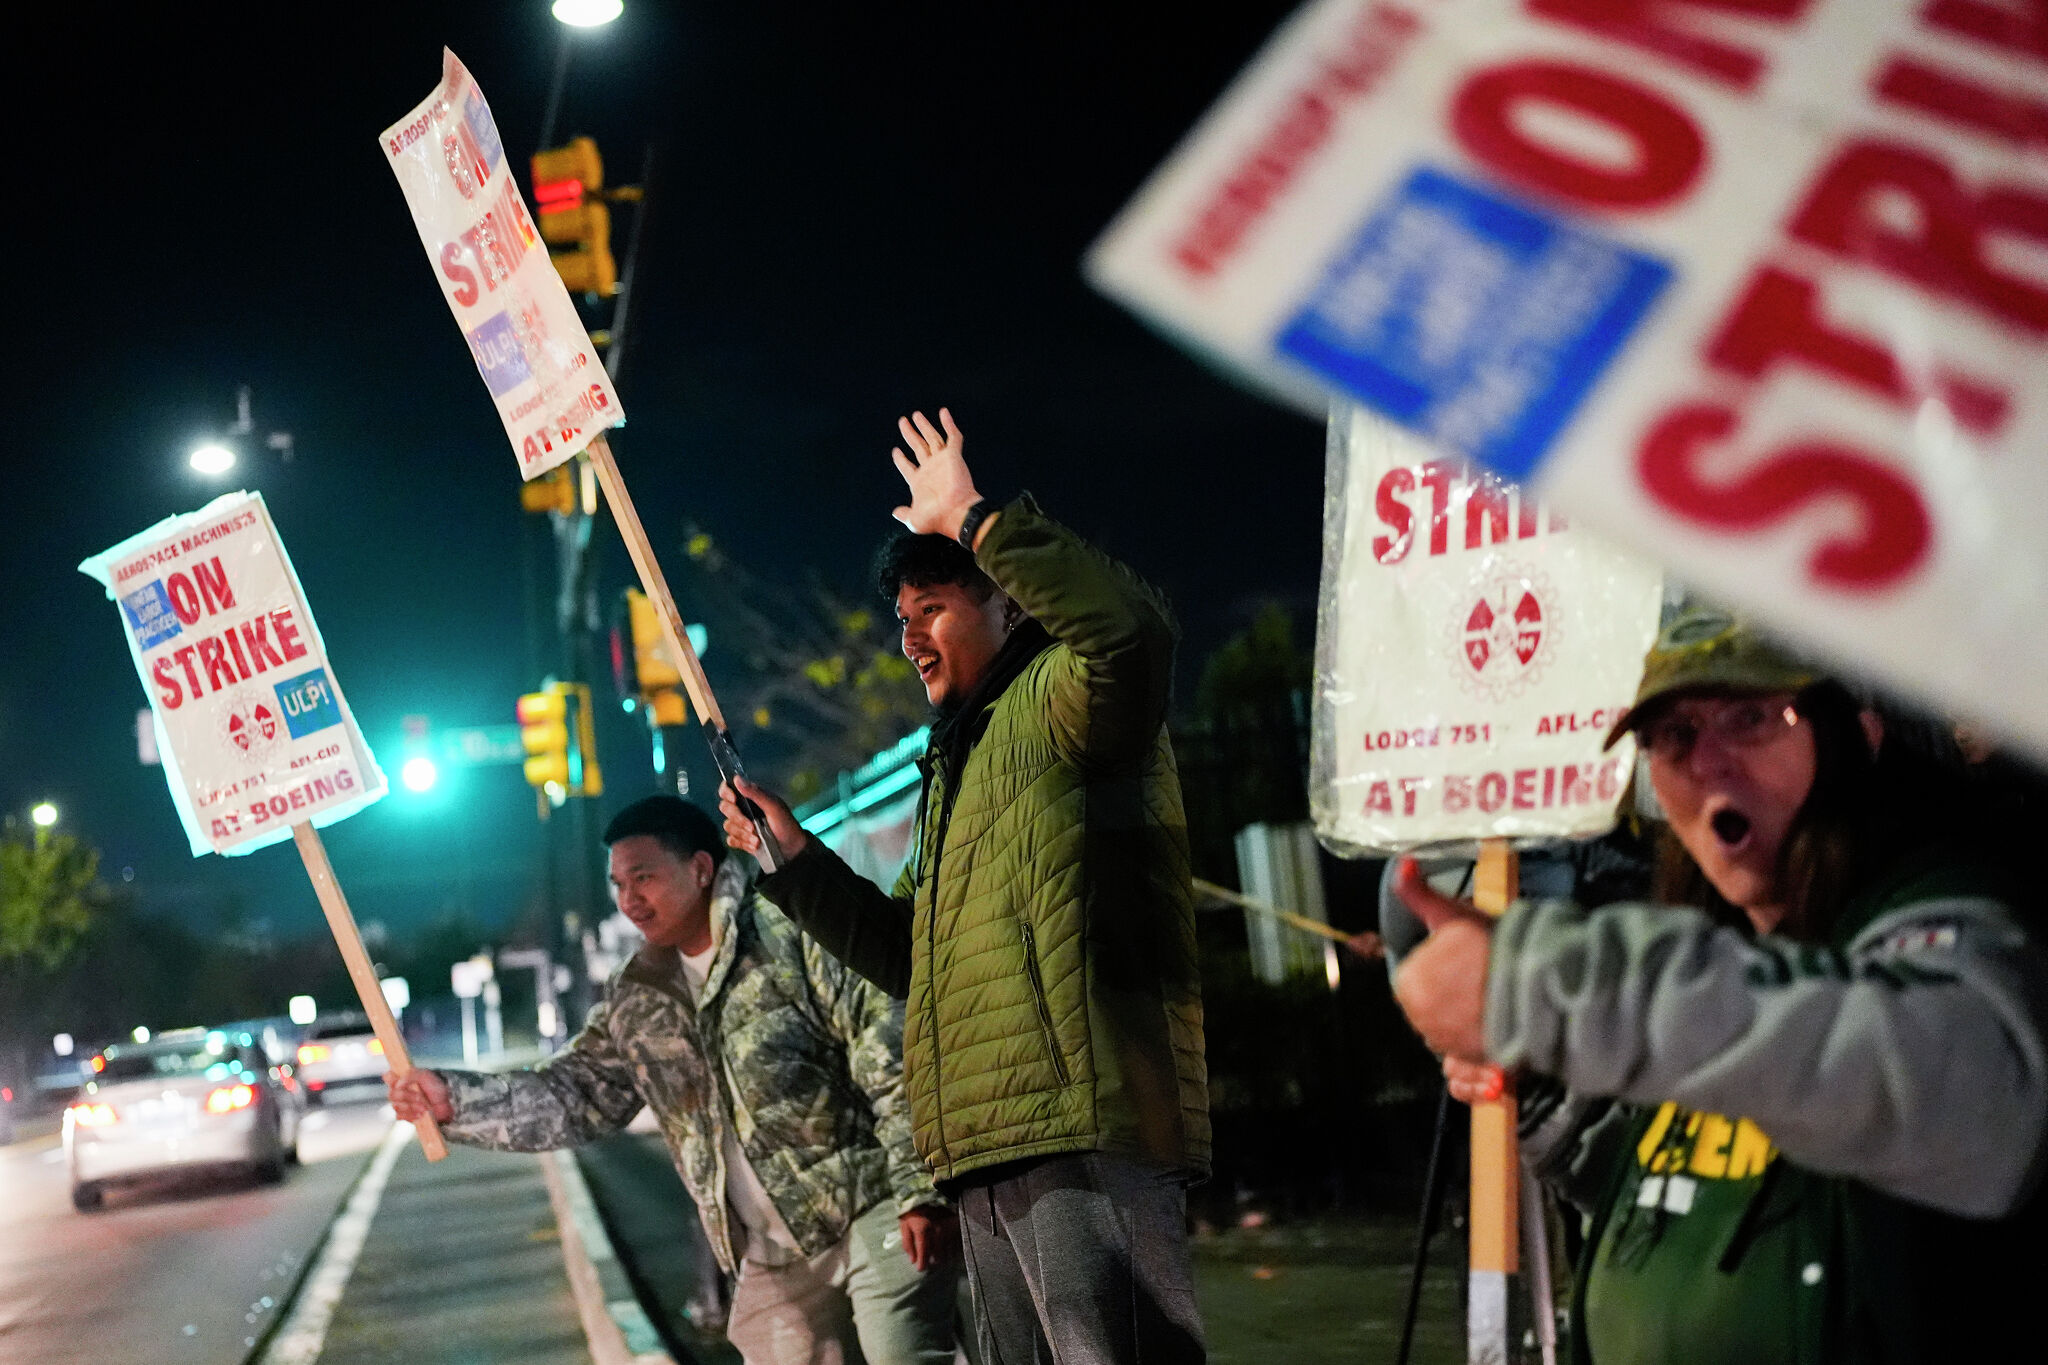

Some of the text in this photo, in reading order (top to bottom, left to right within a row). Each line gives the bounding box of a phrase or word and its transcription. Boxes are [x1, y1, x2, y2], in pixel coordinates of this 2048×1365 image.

[522, 426, 553, 464] AT
[1373, 460, 1568, 565] STRI
[116, 511, 256, 582] AEROSPACE MACHINISTS
[167, 556, 236, 625] ON
[153, 607, 307, 710] STRIKE
[283, 681, 330, 717] ULP!
[290, 744, 340, 770] AFL-CIO
[1451, 723, 1491, 745] 751
[250, 769, 354, 824] BOEING
[1362, 776, 1424, 818] AT
